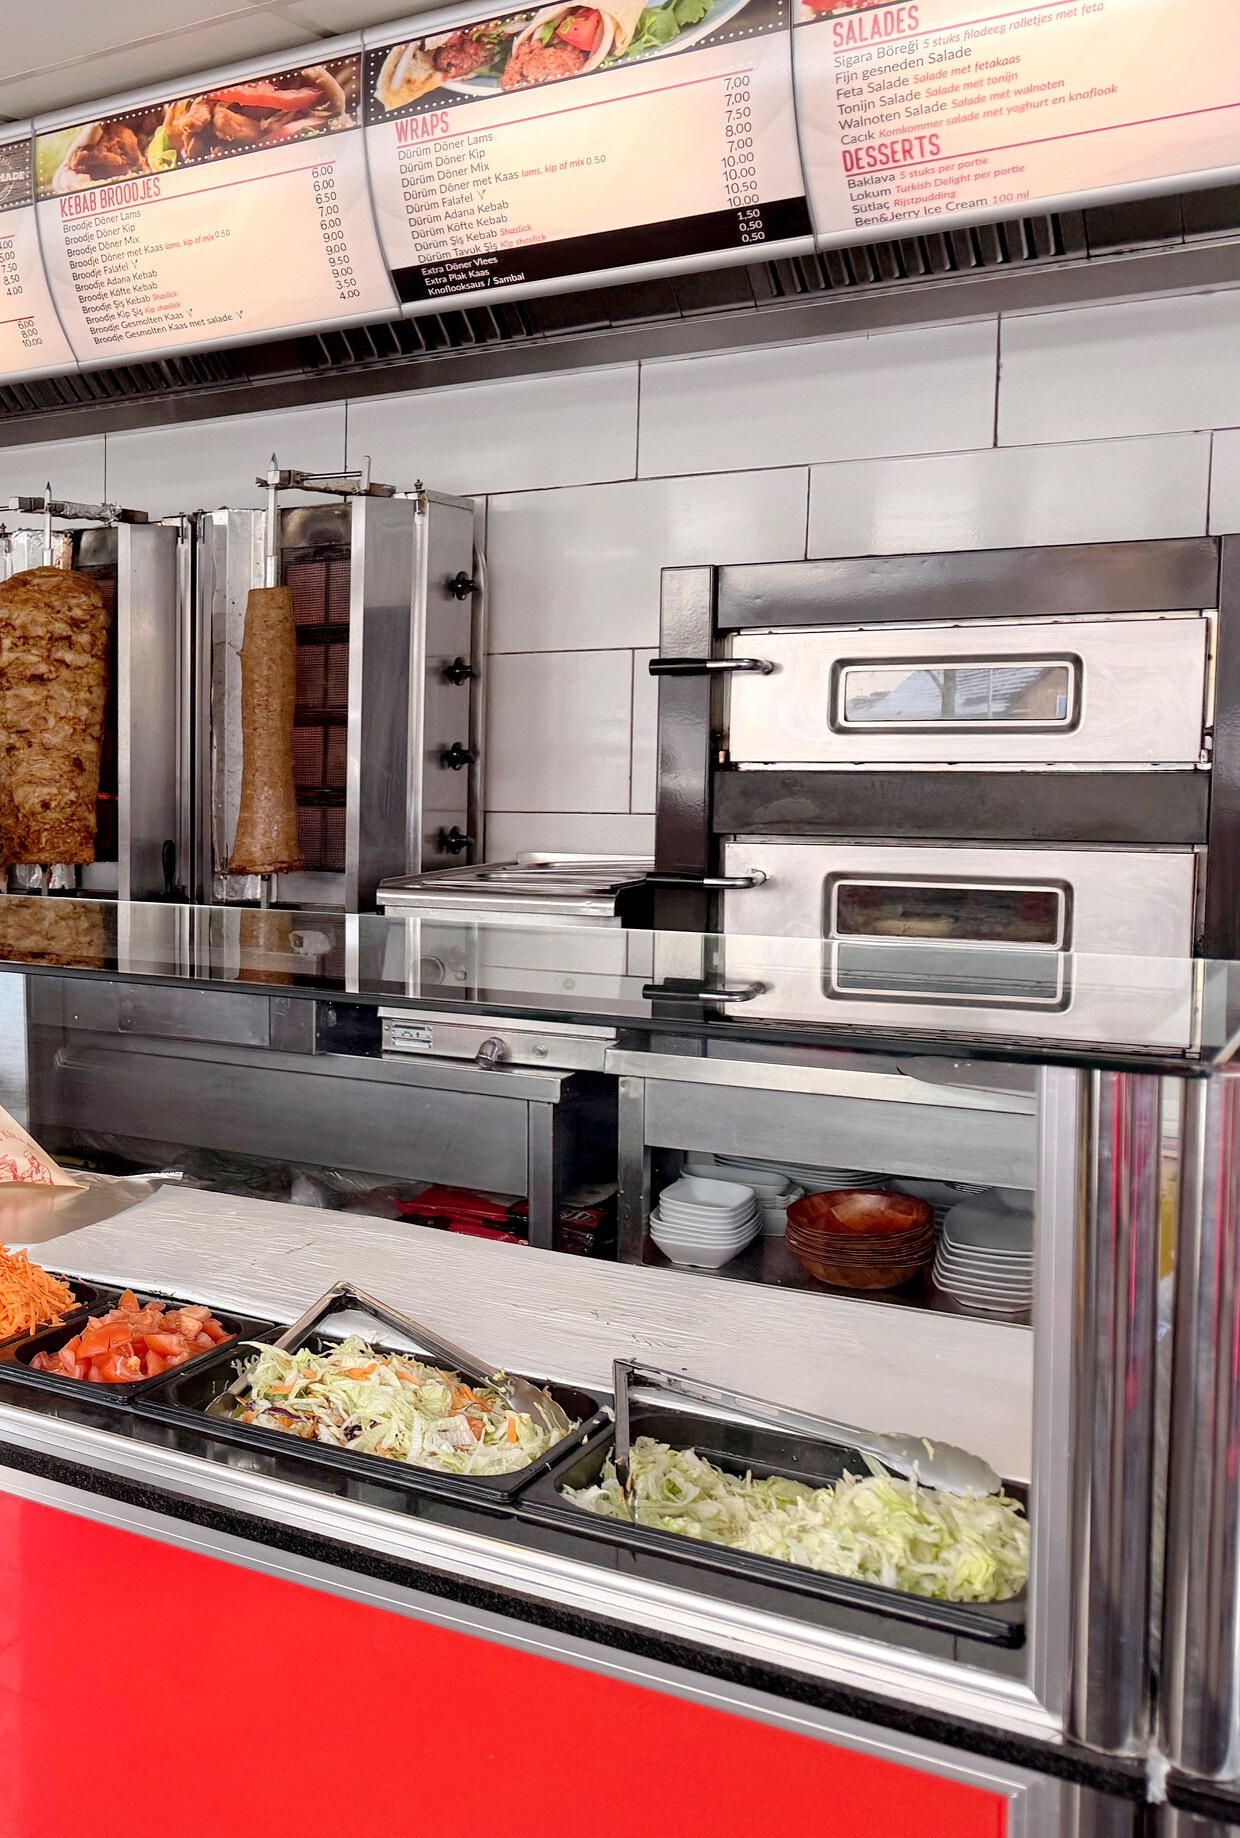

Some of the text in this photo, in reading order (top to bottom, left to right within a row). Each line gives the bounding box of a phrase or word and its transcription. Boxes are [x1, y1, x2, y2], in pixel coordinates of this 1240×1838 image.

[833, 5, 919, 48] SALADES
[834, 2, 1104, 68] Sigara Böreği 5 stuks filodeeg rolletjes met feta
[835, 46, 972, 84] Fijn gesneden Salade
[836, 55, 1021, 100] Feta Salade Salade met fetakaas
[837, 72, 1018, 115] Tonijn Salade Salade met tonijn
[839, 80, 1064, 131] Walnoten Salade Salade met walnoten
[879, 120, 944, 138] Komkommer
[946, 112, 979, 126] salade
[983, 108, 1003, 118] met
[1007, 99, 1048, 115] yoghurt
[1052, 96, 1065, 105] en
[1069, 84, 1118, 102] knoflook
[395, 112, 449, 143] WRAPS
[398, 147, 431, 161] Dürüm
[434, 140, 465, 153] Döner
[468, 133, 493, 146] Lams
[400, 161, 432, 174] Dürüm
[436, 154, 466, 167] Döner
[469, 149, 485, 160] Kip
[842, 133, 940, 172] DESSERTS
[402, 174, 435, 188] Dürüm
[438, 167, 467, 180] Döner
[471, 162, 489, 173] Mix
[403, 188, 436, 201] Dürüm
[440, 181, 470, 194] Döner
[473, 177, 492, 187] met
[495, 170, 519, 183] Kaas
[545, 164, 557, 174] kip
[559, 162, 567, 170] of
[570, 159, 584, 168] mix
[409, 152, 754, 227] Dürüm Adana Kebab 10.00
[848, 157, 989, 188] Baklava 5 stuks per portie
[850, 164, 1025, 201] Lokum Turkish Delight per portie
[60, 177, 161, 217] KEBAB BROODJES
[406, 202, 439, 215] Dürüm
[442, 193, 473, 207] Falafel
[411, 167, 756, 240] Dürüm Köfte Kebab 10.00
[852, 190, 956, 214] Sütlaç Rijstpudding
[855, 190, 1029, 226] Ben&Jerry Ice Cream 100 ml
[63, 220, 92, 234] Broodje
[95, 215, 118, 227] Döner
[121, 210, 141, 221] Lams
[415, 240, 447, 252] Dürüm
[467, 230, 497, 242] Kebab
[500, 224, 532, 236] Shaslick
[724, 181, 757, 194] 10.50
[418, 251, 451, 264] Dürüm
[453, 245, 481, 256] Tavuk
[727, 194, 759, 207] 10.00
[67, 245, 97, 257] Broodje
[99, 239, 123, 250] Döner
[125, 236, 140, 245] Mix
[75, 281, 105, 292] Broodje
[107, 276, 131, 286] Adana
[132, 270, 158, 281] Kebab
[421, 266, 444, 276] Extra
[446, 261, 472, 271] Döner
[473, 256, 498, 266] Vlees
[424, 276, 447, 285] Extra
[449, 274, 467, 282] Plak
[469, 269, 490, 278] Kaas
[428, 281, 485, 295] Knoflooksaus
[493, 273, 525, 285] Sambal
[90, 324, 120, 335] Broodje
[121, 316, 163, 329] Gesmolten
[164, 312, 184, 321] Kaas
[94, 334, 124, 345] Broodje
[125, 326, 167, 339] Gesmolten
[169, 322, 188, 331] Kaas
[208, 313, 233, 325] salade
